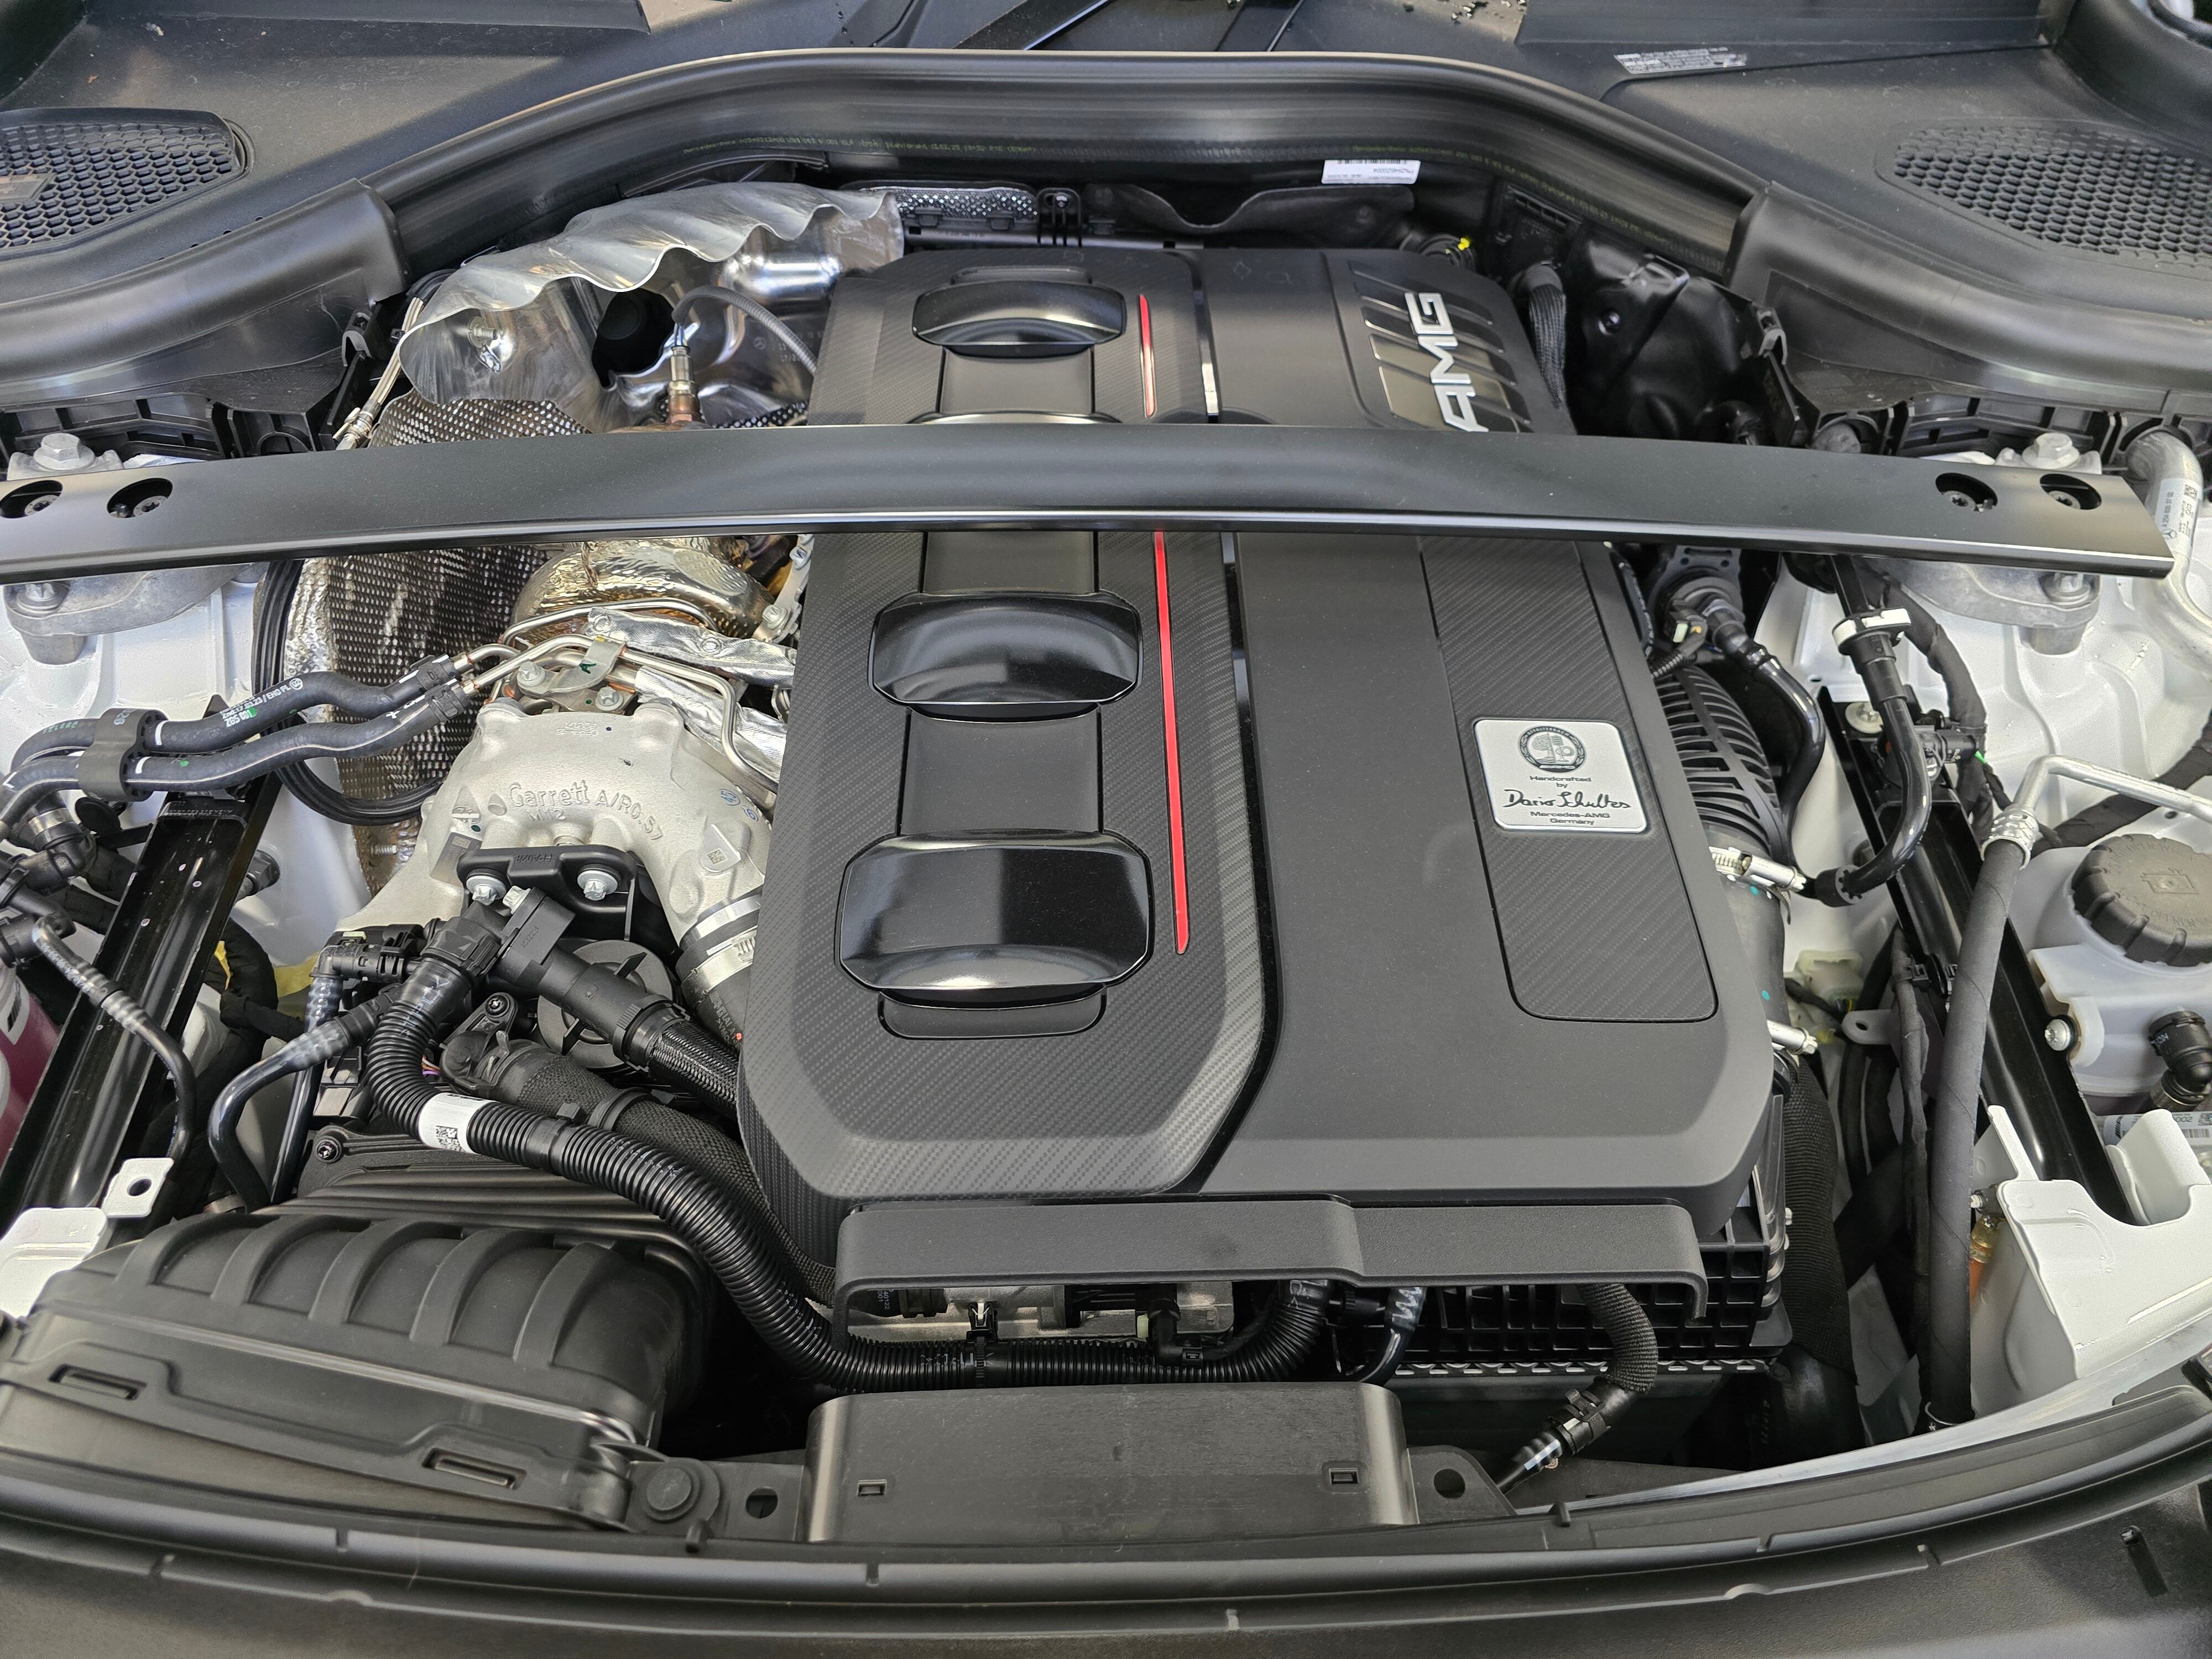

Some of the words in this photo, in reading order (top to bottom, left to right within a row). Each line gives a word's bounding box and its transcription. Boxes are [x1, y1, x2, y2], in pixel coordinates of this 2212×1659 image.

[1404, 293, 1489, 432] AMG
[508, 780, 590, 807] Garrett
[1502, 789, 1556, 807] Dario
[527, 807, 567, 822] M12
